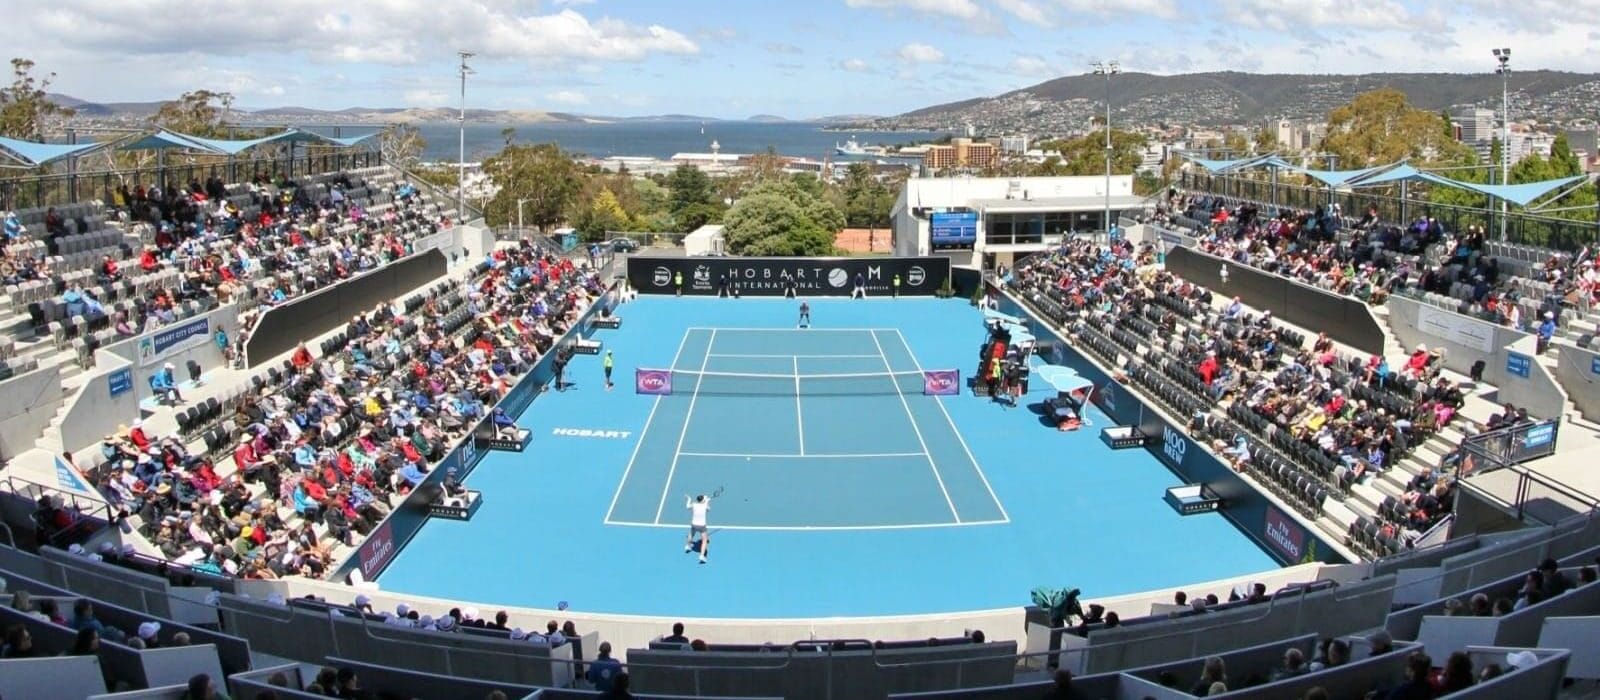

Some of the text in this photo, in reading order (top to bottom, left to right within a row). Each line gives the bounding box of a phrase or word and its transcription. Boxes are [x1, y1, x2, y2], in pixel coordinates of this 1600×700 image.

[729, 268, 823, 278] HOBART
[868, 265, 881, 280] M
[729, 281, 821, 289] INTERNATONAL
[155, 322, 208, 345] HOBART CITY COUNCIL
[643, 378, 665, 386] WTA
[552, 427, 632, 439] HOBART
[1162, 425, 1186, 455] MOO
[1163, 440, 1184, 465] BREW
[1279, 521, 1289, 537] Fly
[372, 537, 382, 551] Fly
[1266, 522, 1298, 557] Emirates
[363, 539, 392, 575] Emirates
